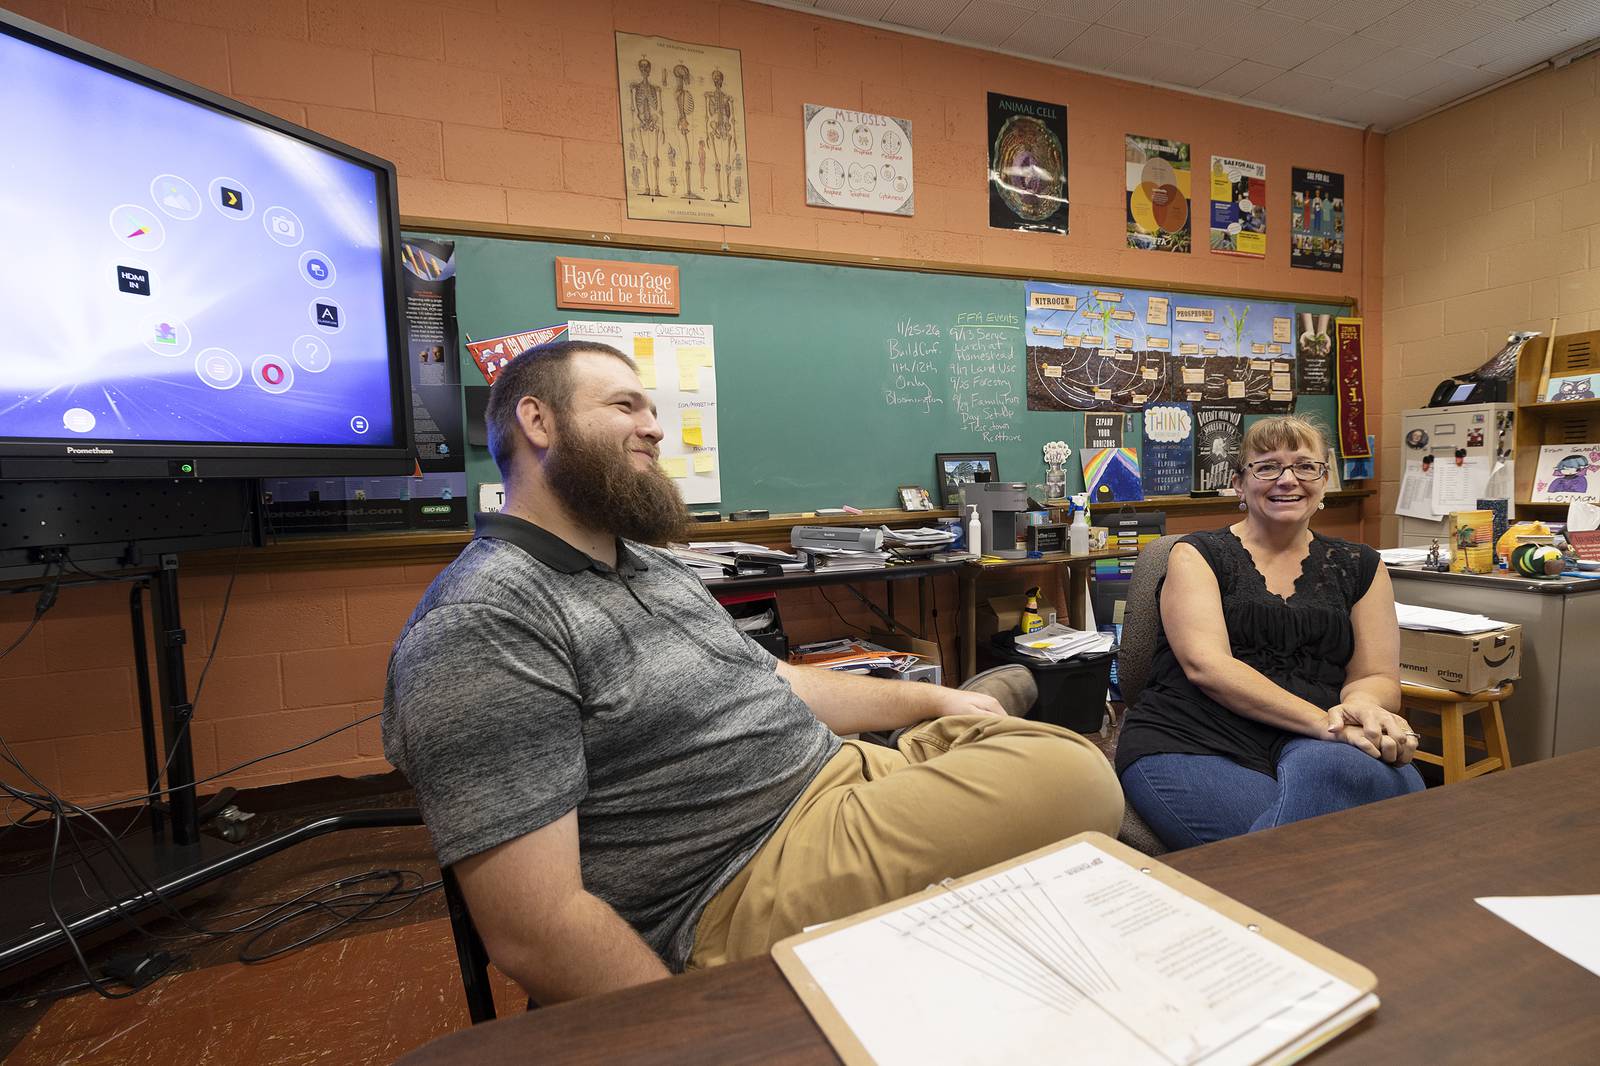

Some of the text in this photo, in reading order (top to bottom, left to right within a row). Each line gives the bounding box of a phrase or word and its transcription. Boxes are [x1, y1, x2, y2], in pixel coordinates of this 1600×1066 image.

[999, 100, 1056, 120] ANIMAL CELL
[836, 110, 887, 126] MITOSIS
[121, 270, 146, 283] HDMI
[563, 264, 672, 293] Have courage
[130, 280, 138, 289] IN
[590, 288, 672, 306] and be kind.
[957, 312, 1019, 324] FFA Events
[570, 322, 595, 334] APPLE
[656, 324, 704, 336] QUESTIONS
[957, 346, 1014, 361] Homestead
[1096, 418, 1114, 426] EXPAND
[1148, 412, 1186, 431] THINK
[1098, 429, 1110, 437] YOUR
[1093, 440, 1116, 448] HORIZONS
[66, 446, 114, 455] Promethean
[1438, 669, 1463, 679] prime
